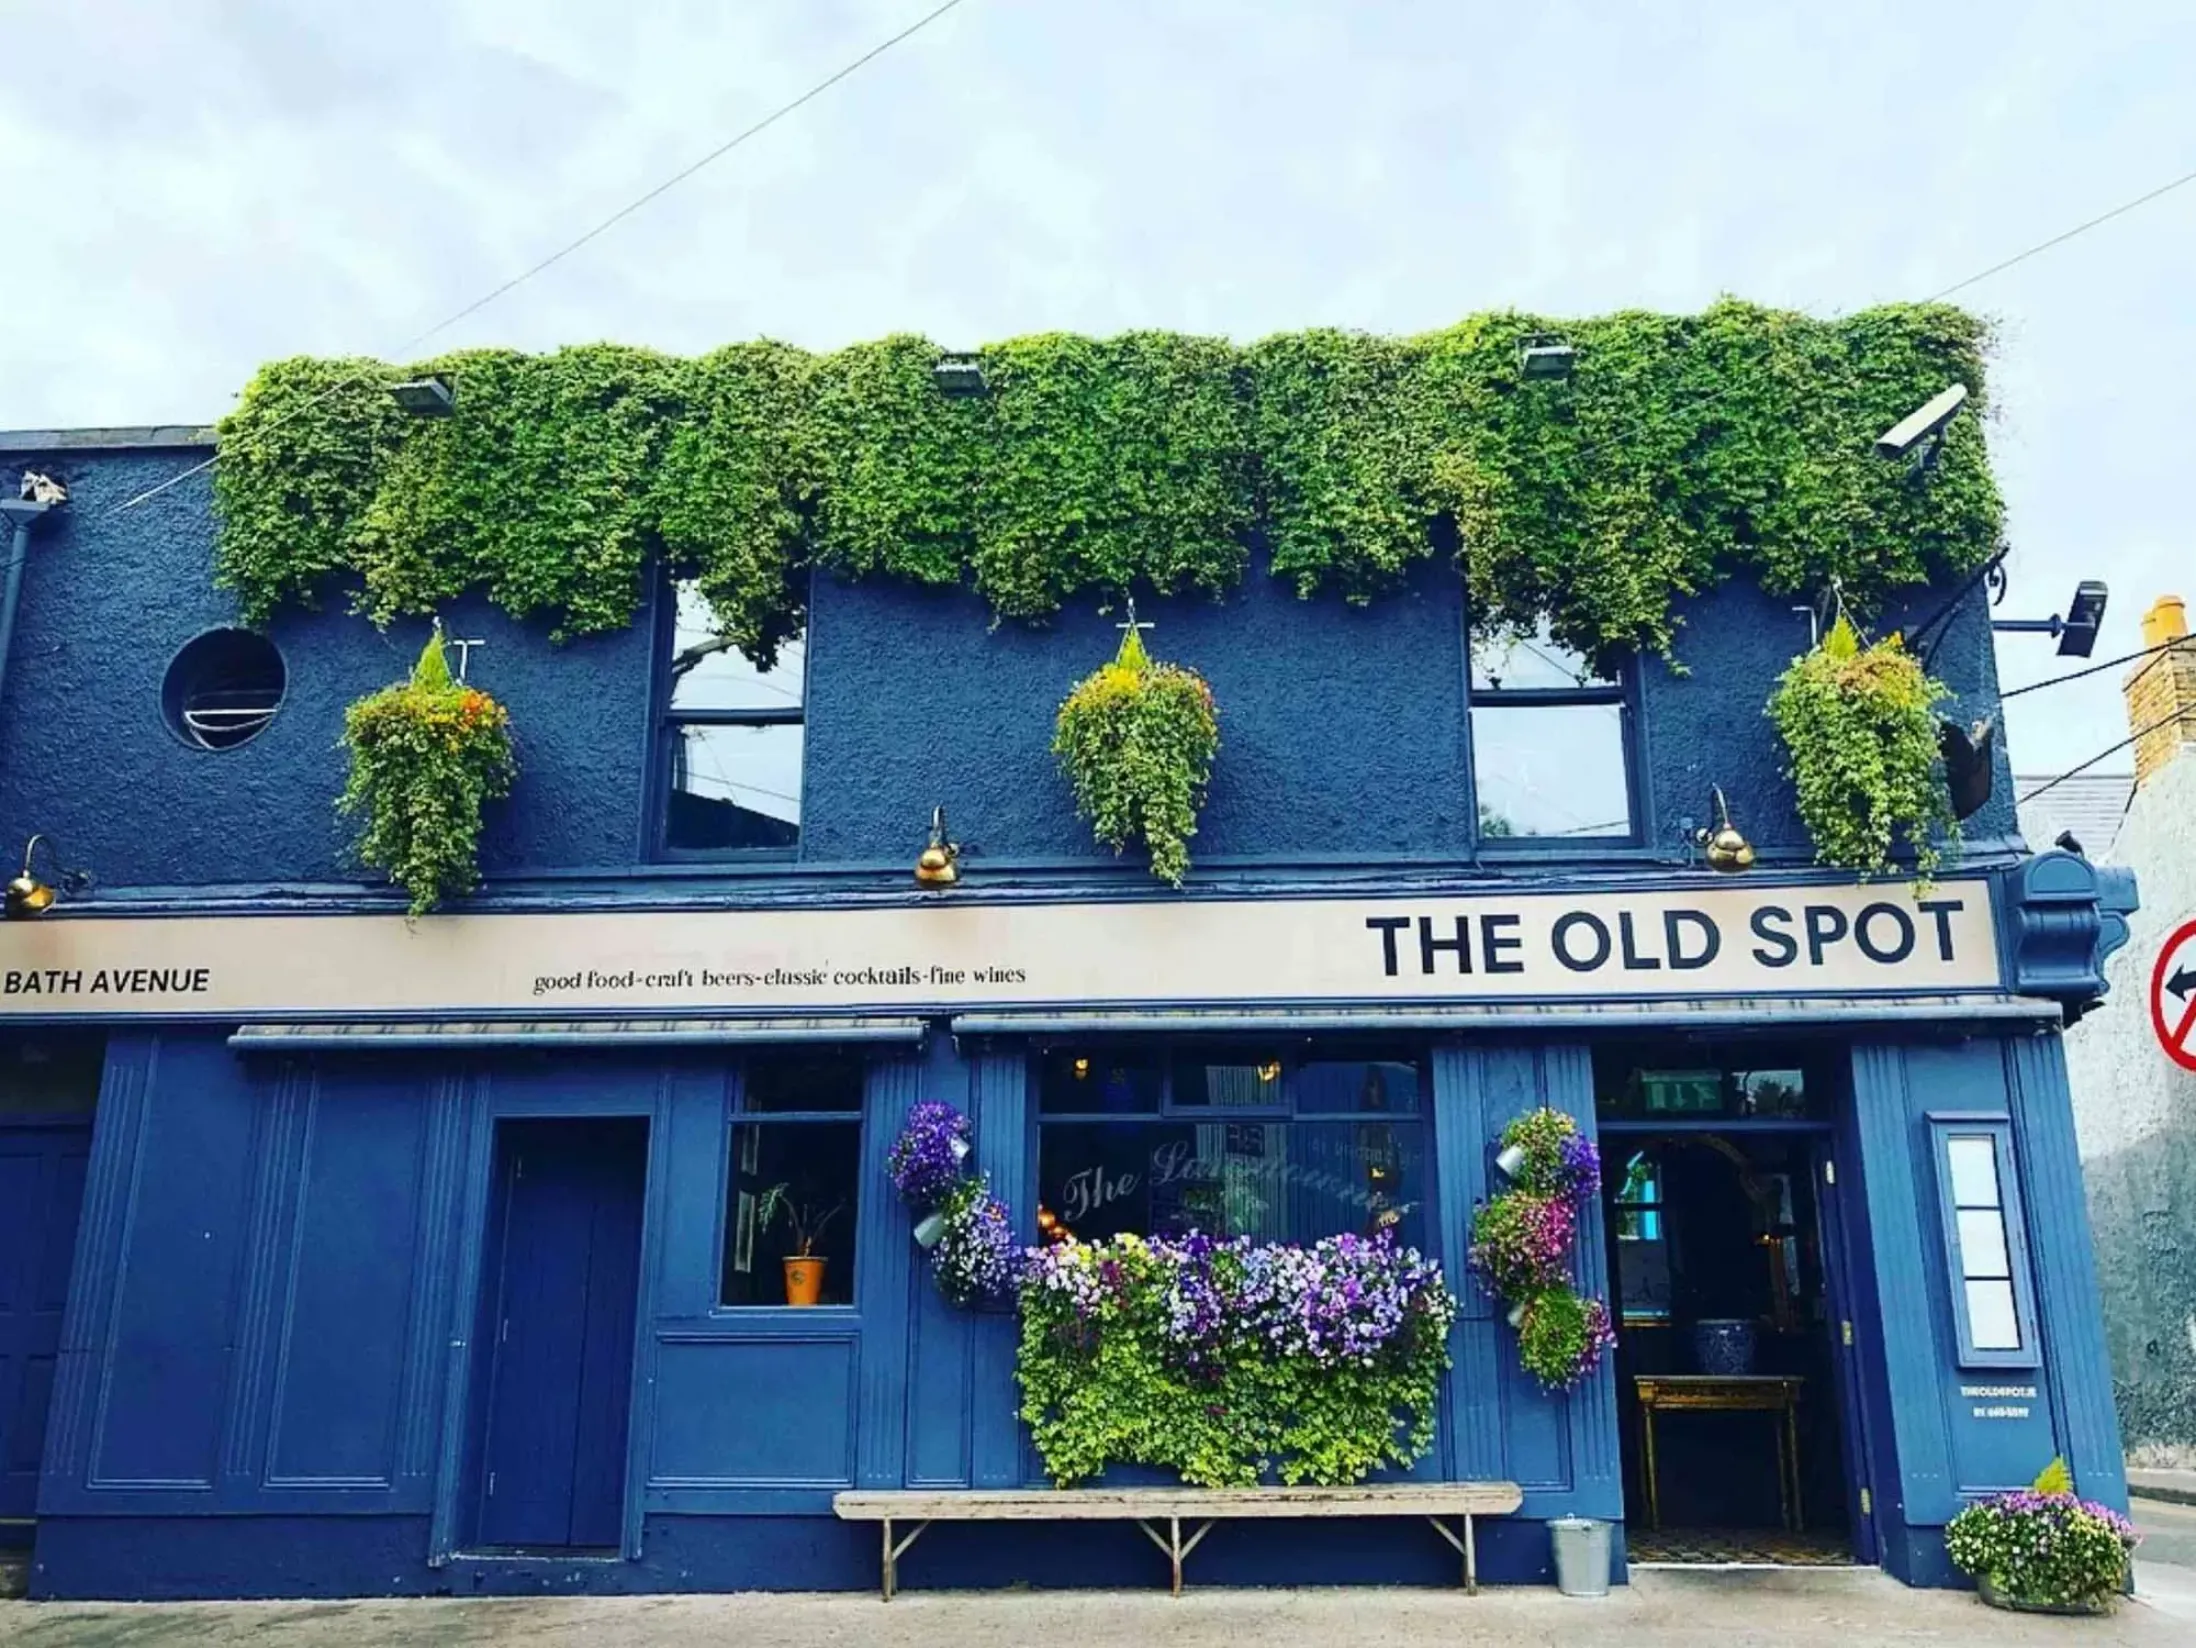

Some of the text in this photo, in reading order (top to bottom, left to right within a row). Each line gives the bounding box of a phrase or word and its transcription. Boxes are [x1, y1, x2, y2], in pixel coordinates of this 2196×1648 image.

[1366, 901, 1963, 976] THE OLD SPOT
[4, 969, 209, 994] BATH AVENUE
[534, 973, 581, 995] good
[588, 970, 692, 988] food-craft
[974, 967, 1025, 982] wines
[1063, 1165, 1142, 1222] The
